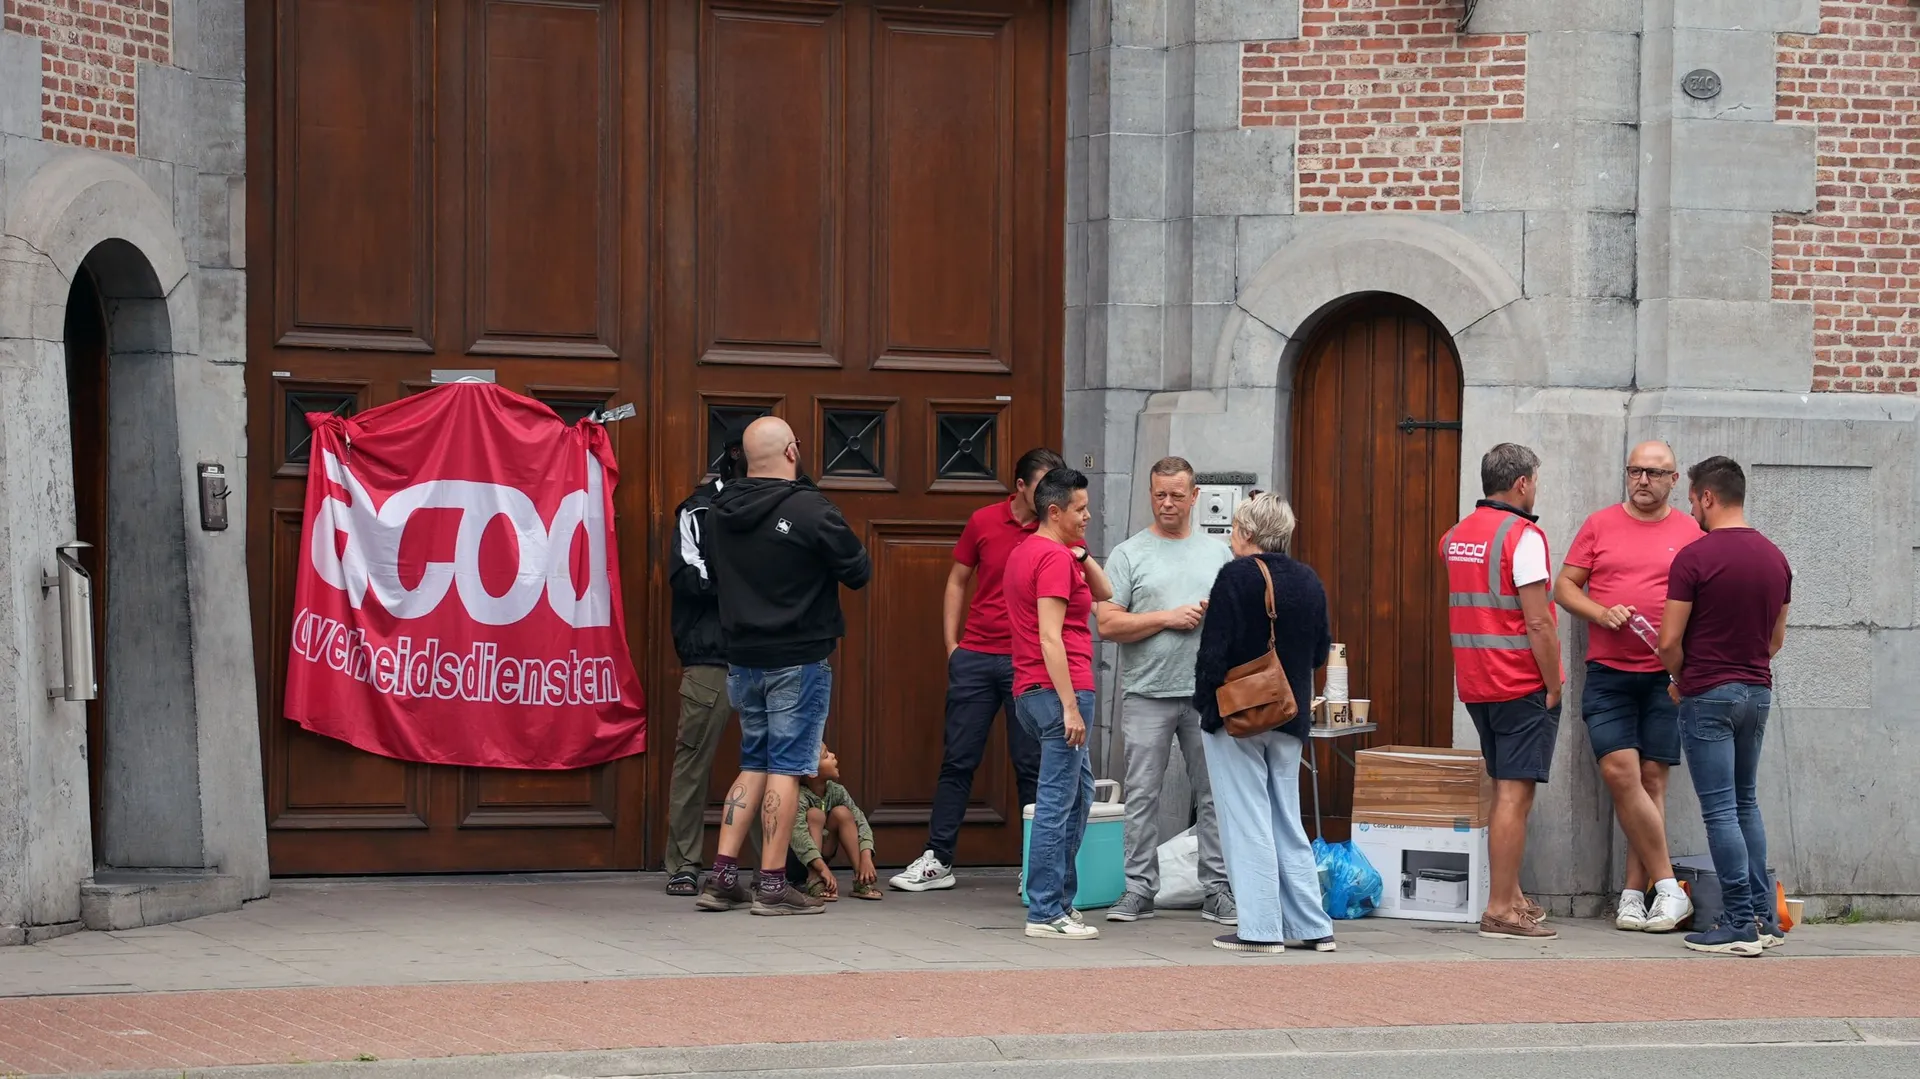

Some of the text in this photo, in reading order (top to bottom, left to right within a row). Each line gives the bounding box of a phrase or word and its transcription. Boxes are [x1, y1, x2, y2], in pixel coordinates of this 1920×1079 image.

[1689, 75, 1716, 91] 310
[311, 447, 611, 629] acod
[1448, 540, 1488, 557] acod
[292, 607, 621, 707] overheidsdiensten
